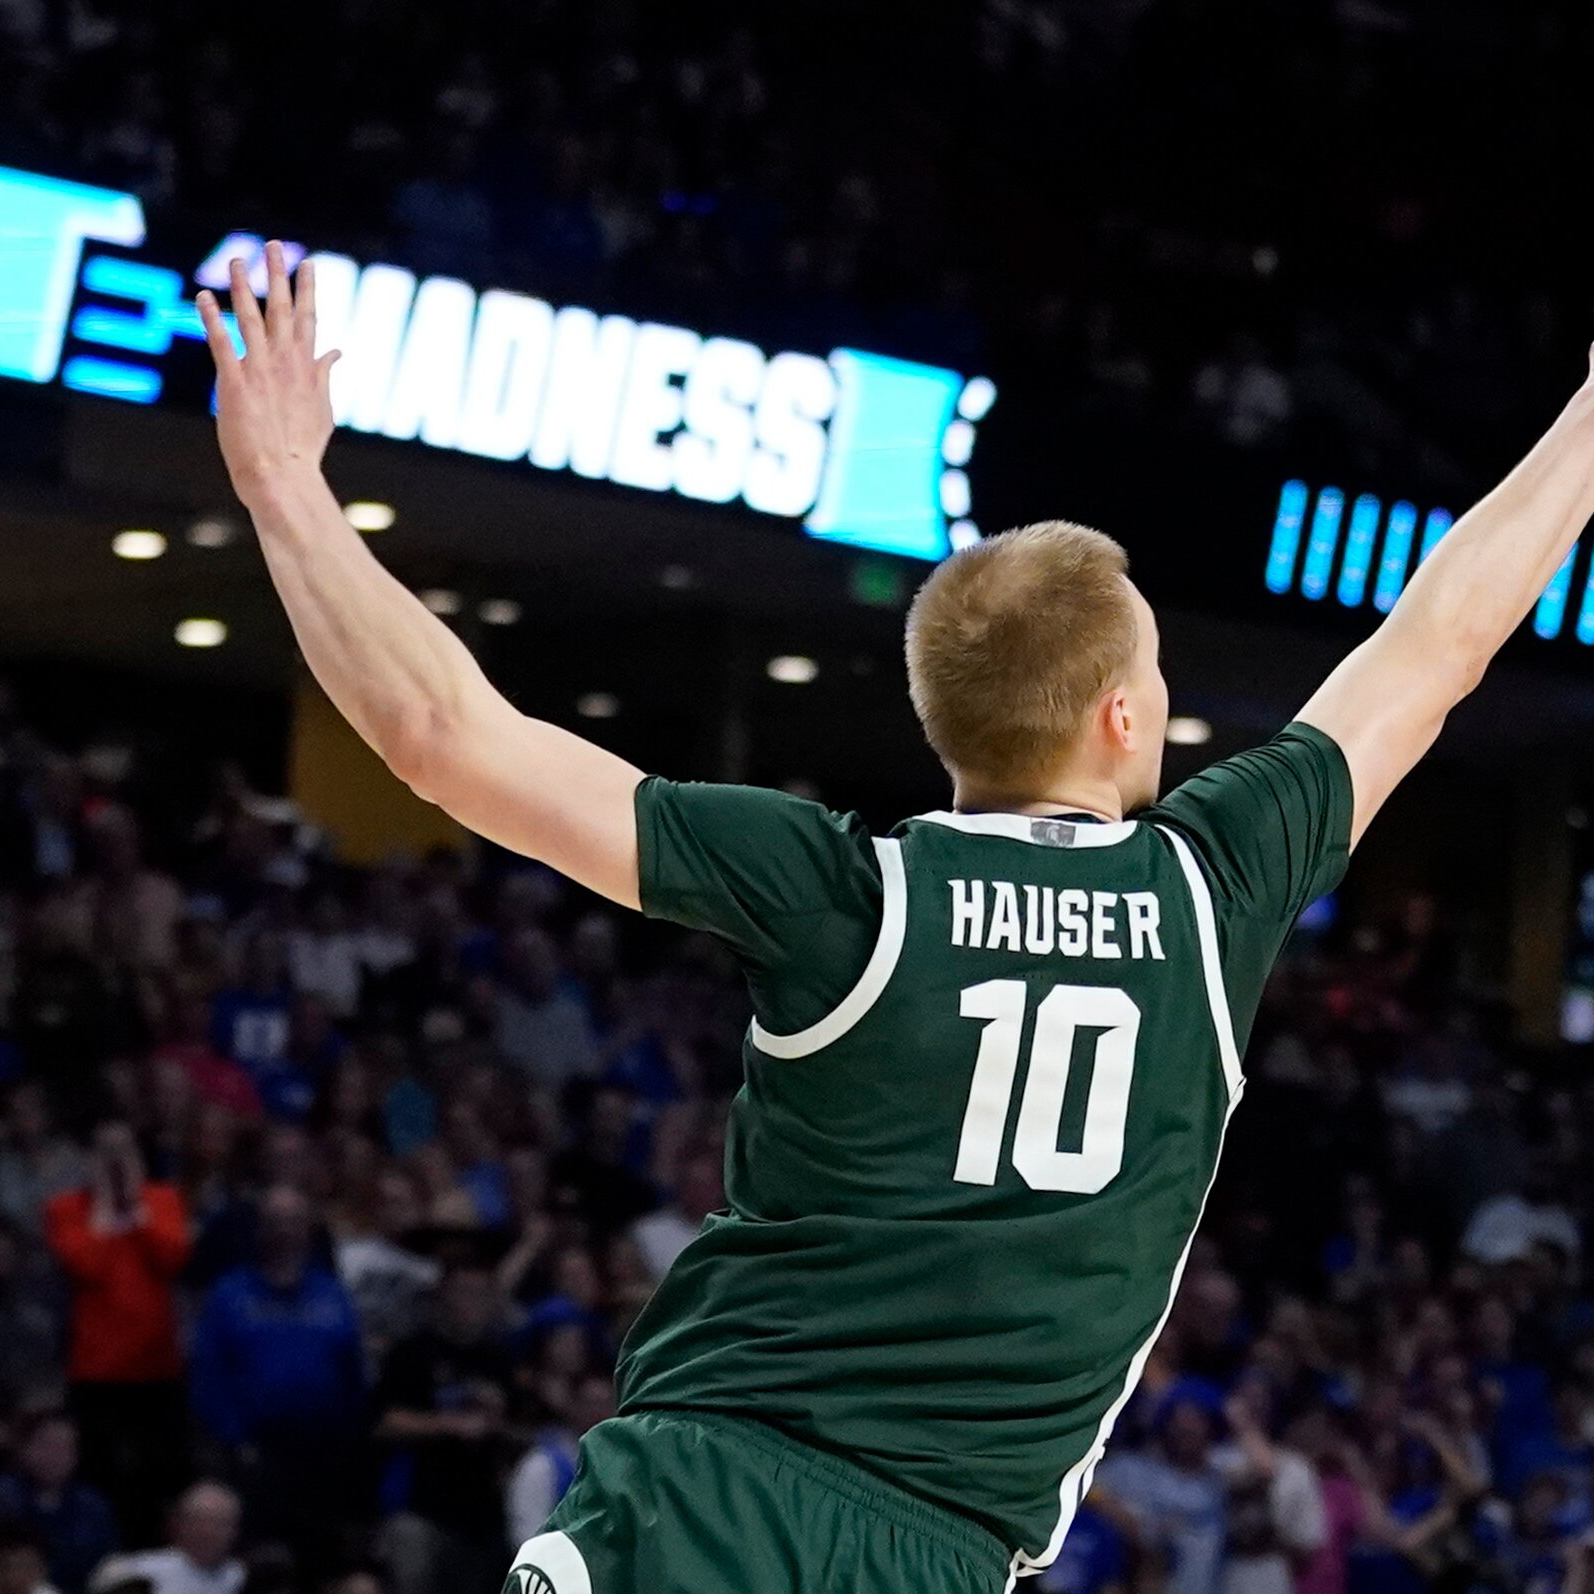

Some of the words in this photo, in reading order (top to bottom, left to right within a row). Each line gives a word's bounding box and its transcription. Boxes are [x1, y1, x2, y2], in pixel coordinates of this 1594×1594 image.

[309, 250, 838, 518] MADNESS
[947, 878, 1166, 961] HAUSER
[953, 978, 1142, 1195] 10
